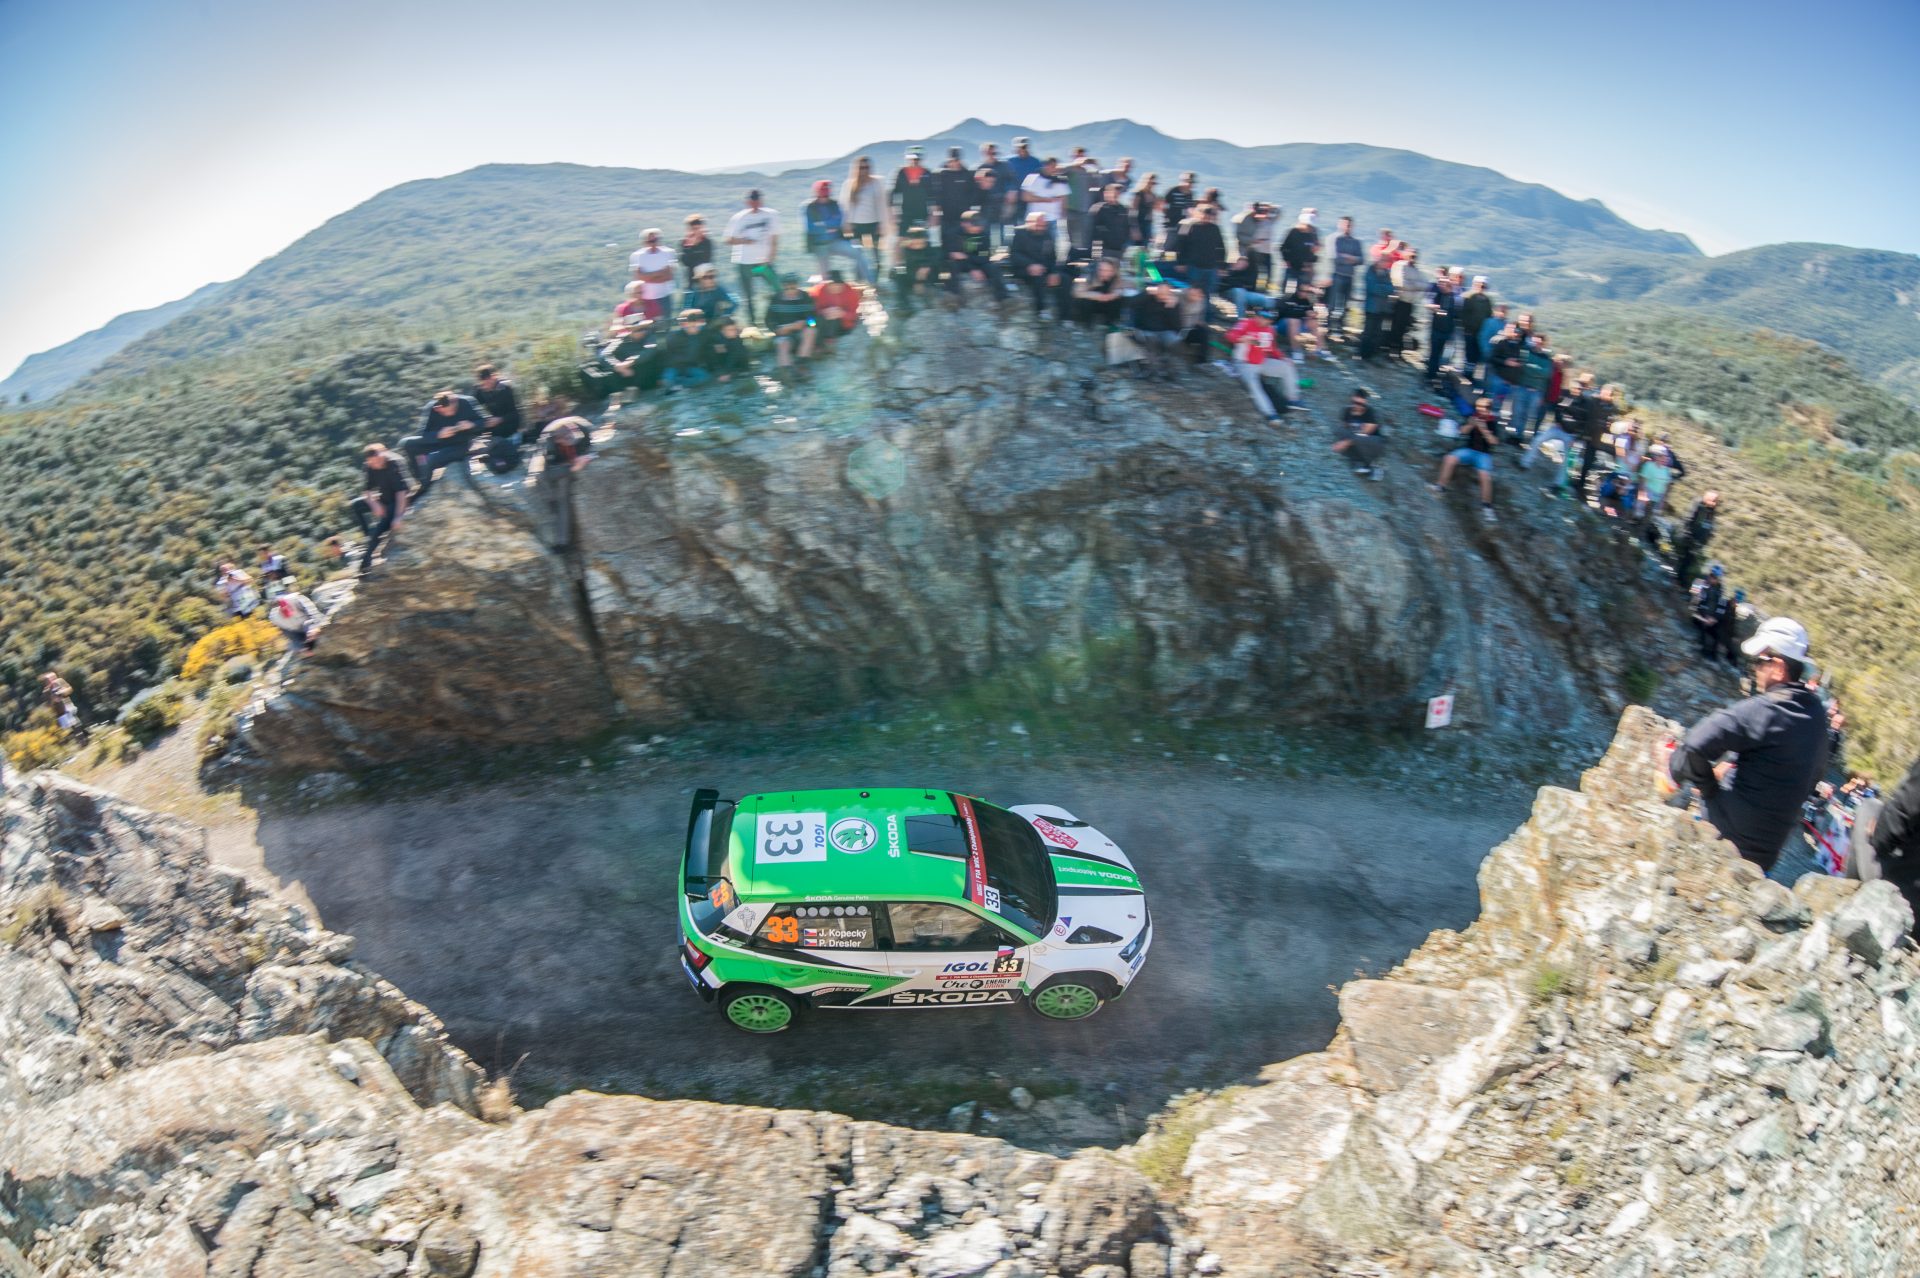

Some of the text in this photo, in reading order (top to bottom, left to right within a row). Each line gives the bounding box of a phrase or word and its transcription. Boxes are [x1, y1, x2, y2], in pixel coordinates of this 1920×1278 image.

[764, 820, 804, 857] 33
[814, 824, 825, 848] IGOL
[986, 890, 999, 908] 33
[767, 916, 799, 943] 33
[818, 928, 867, 939] J. Kopecký
[829, 940, 861, 948] Dresler
[943, 962, 989, 972] IGOL
[997, 959, 1019, 972] 33
[892, 990, 1013, 1004] ŠKODA
